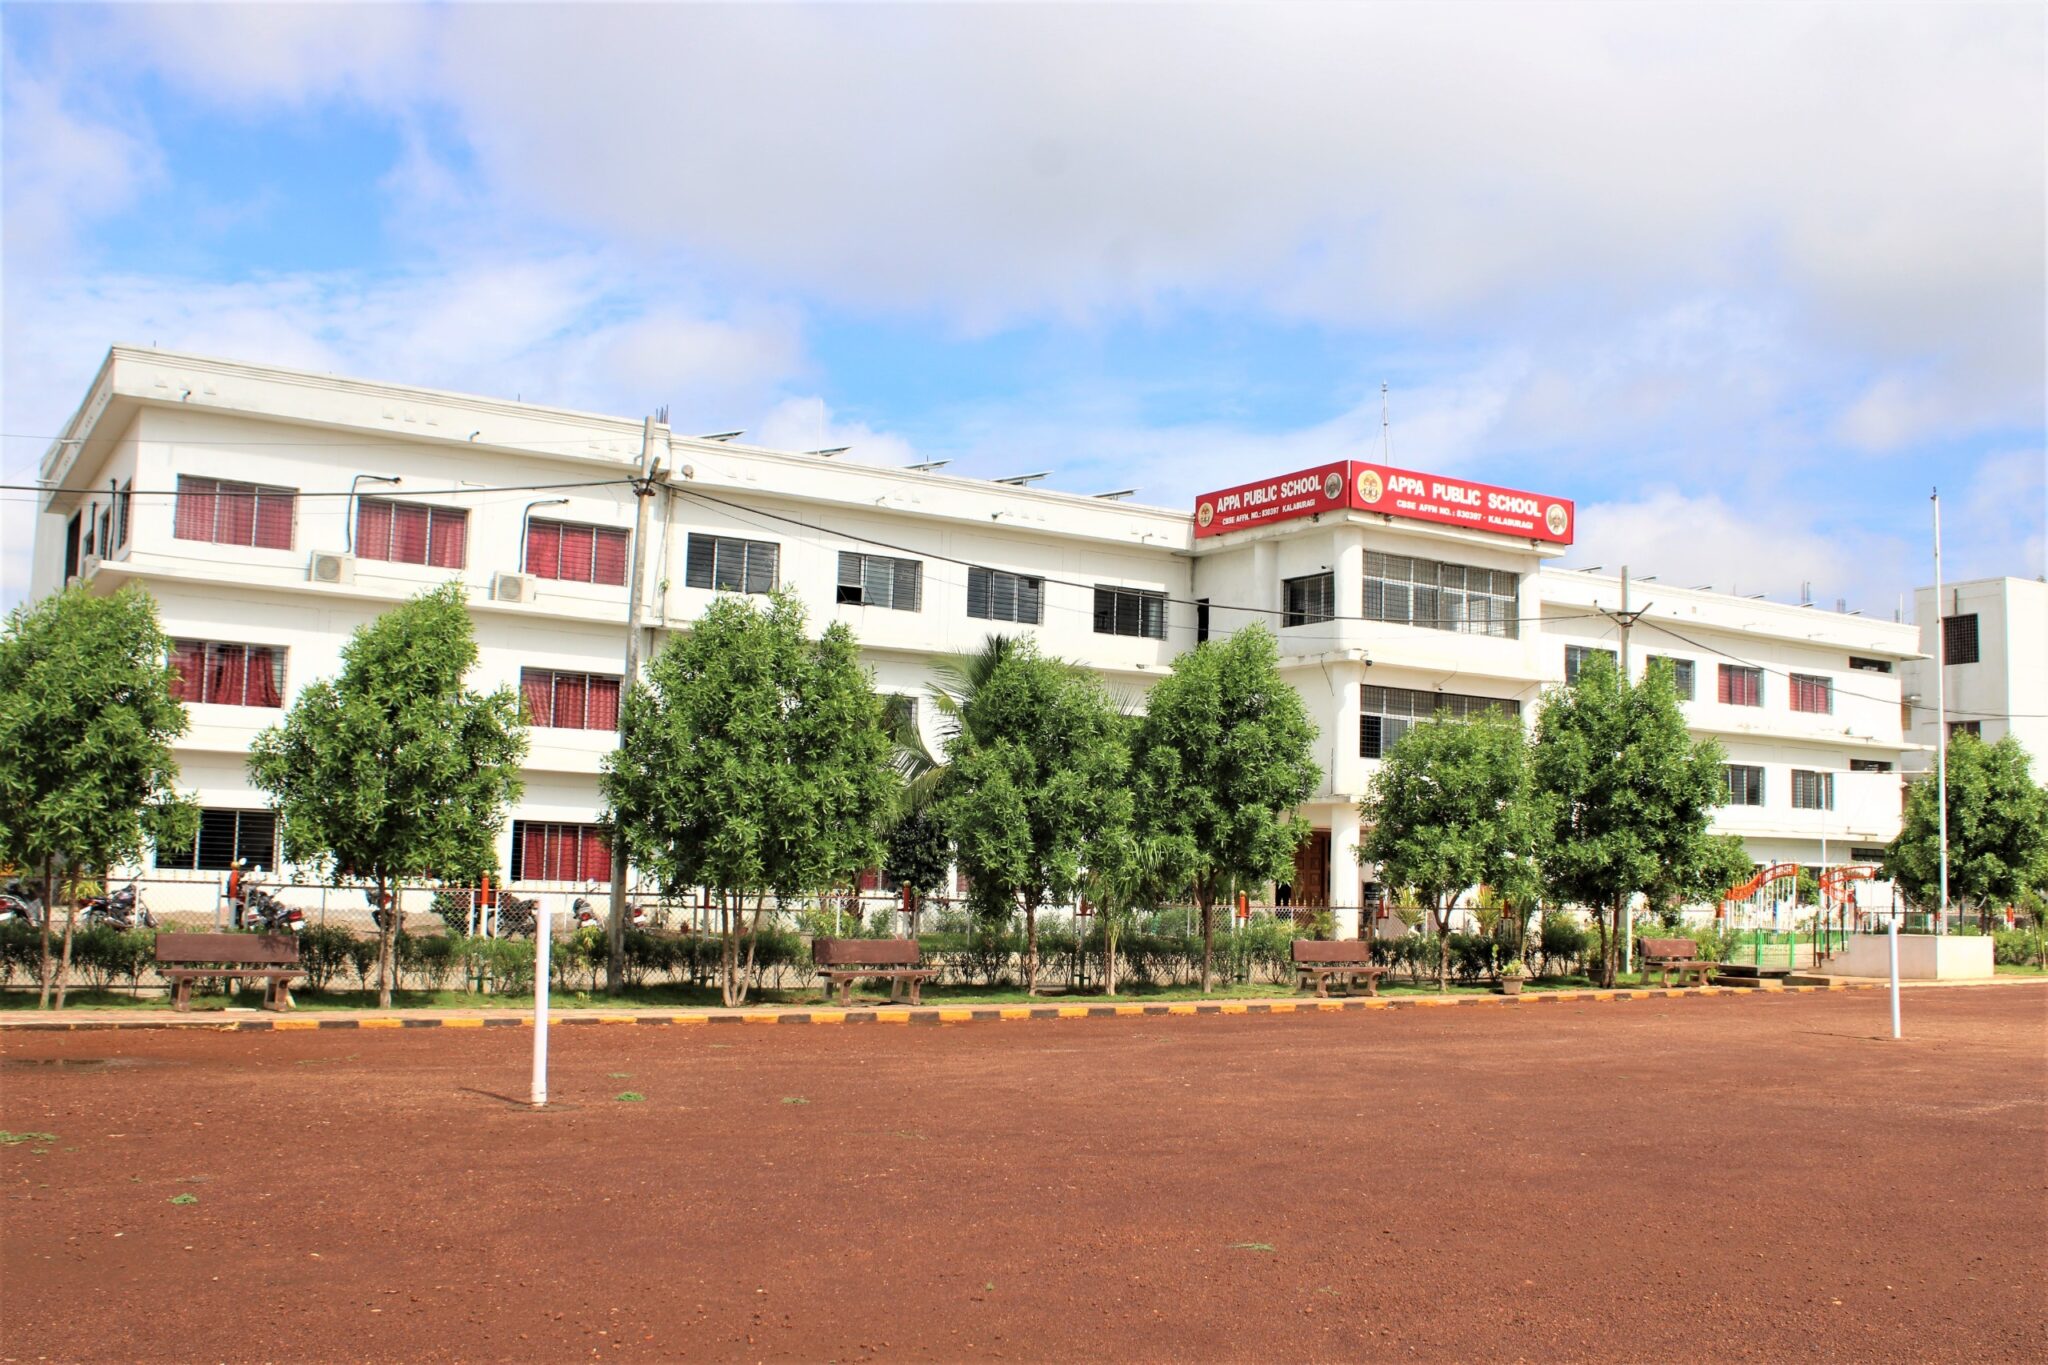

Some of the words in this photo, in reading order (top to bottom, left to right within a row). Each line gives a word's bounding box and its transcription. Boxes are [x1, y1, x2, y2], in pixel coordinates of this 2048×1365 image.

[1217, 494, 1241, 513] APPA
[1243, 485, 1278, 507] PUBLIC
[1280, 474, 1322, 499] SCHOOL
[1387, 474, 1425, 497] APPA
[1432, 482, 1482, 506] PUBLIC
[1487, 492, 1542, 517] SCHOOL
[1396, 499, 1417, 510] CBSE
[1222, 516, 1236, 526] CBSE
